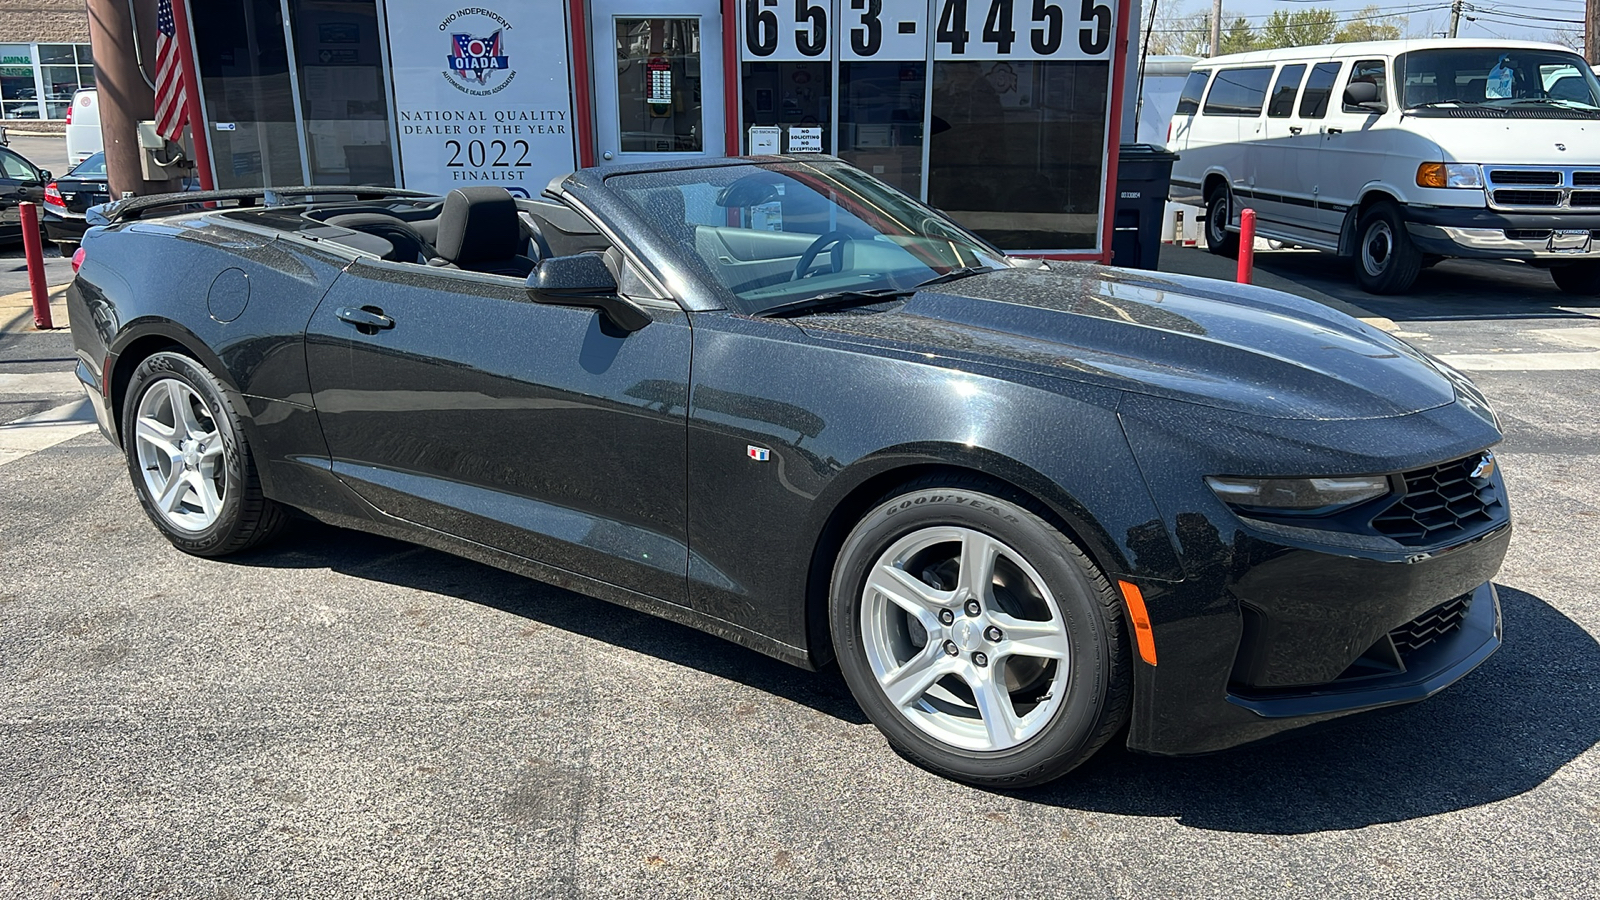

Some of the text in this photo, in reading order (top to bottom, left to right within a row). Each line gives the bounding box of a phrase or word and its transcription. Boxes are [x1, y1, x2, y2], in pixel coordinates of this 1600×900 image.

[439, 7, 513, 31] OHIO INDEPENDENT
[455, 57, 499, 69] OIADA
[442, 70, 469, 95] AUTOMOBILE
[492, 70, 517, 94] ASSOCIATION
[401, 110, 566, 123] NATIONAL QUALITY
[404, 125, 565, 134] DEALER OF THE YEAR
[445, 139, 532, 167] 2022
[453, 171, 525, 180] FINALIST
[886, 494, 1020, 525] GOODYEAR
